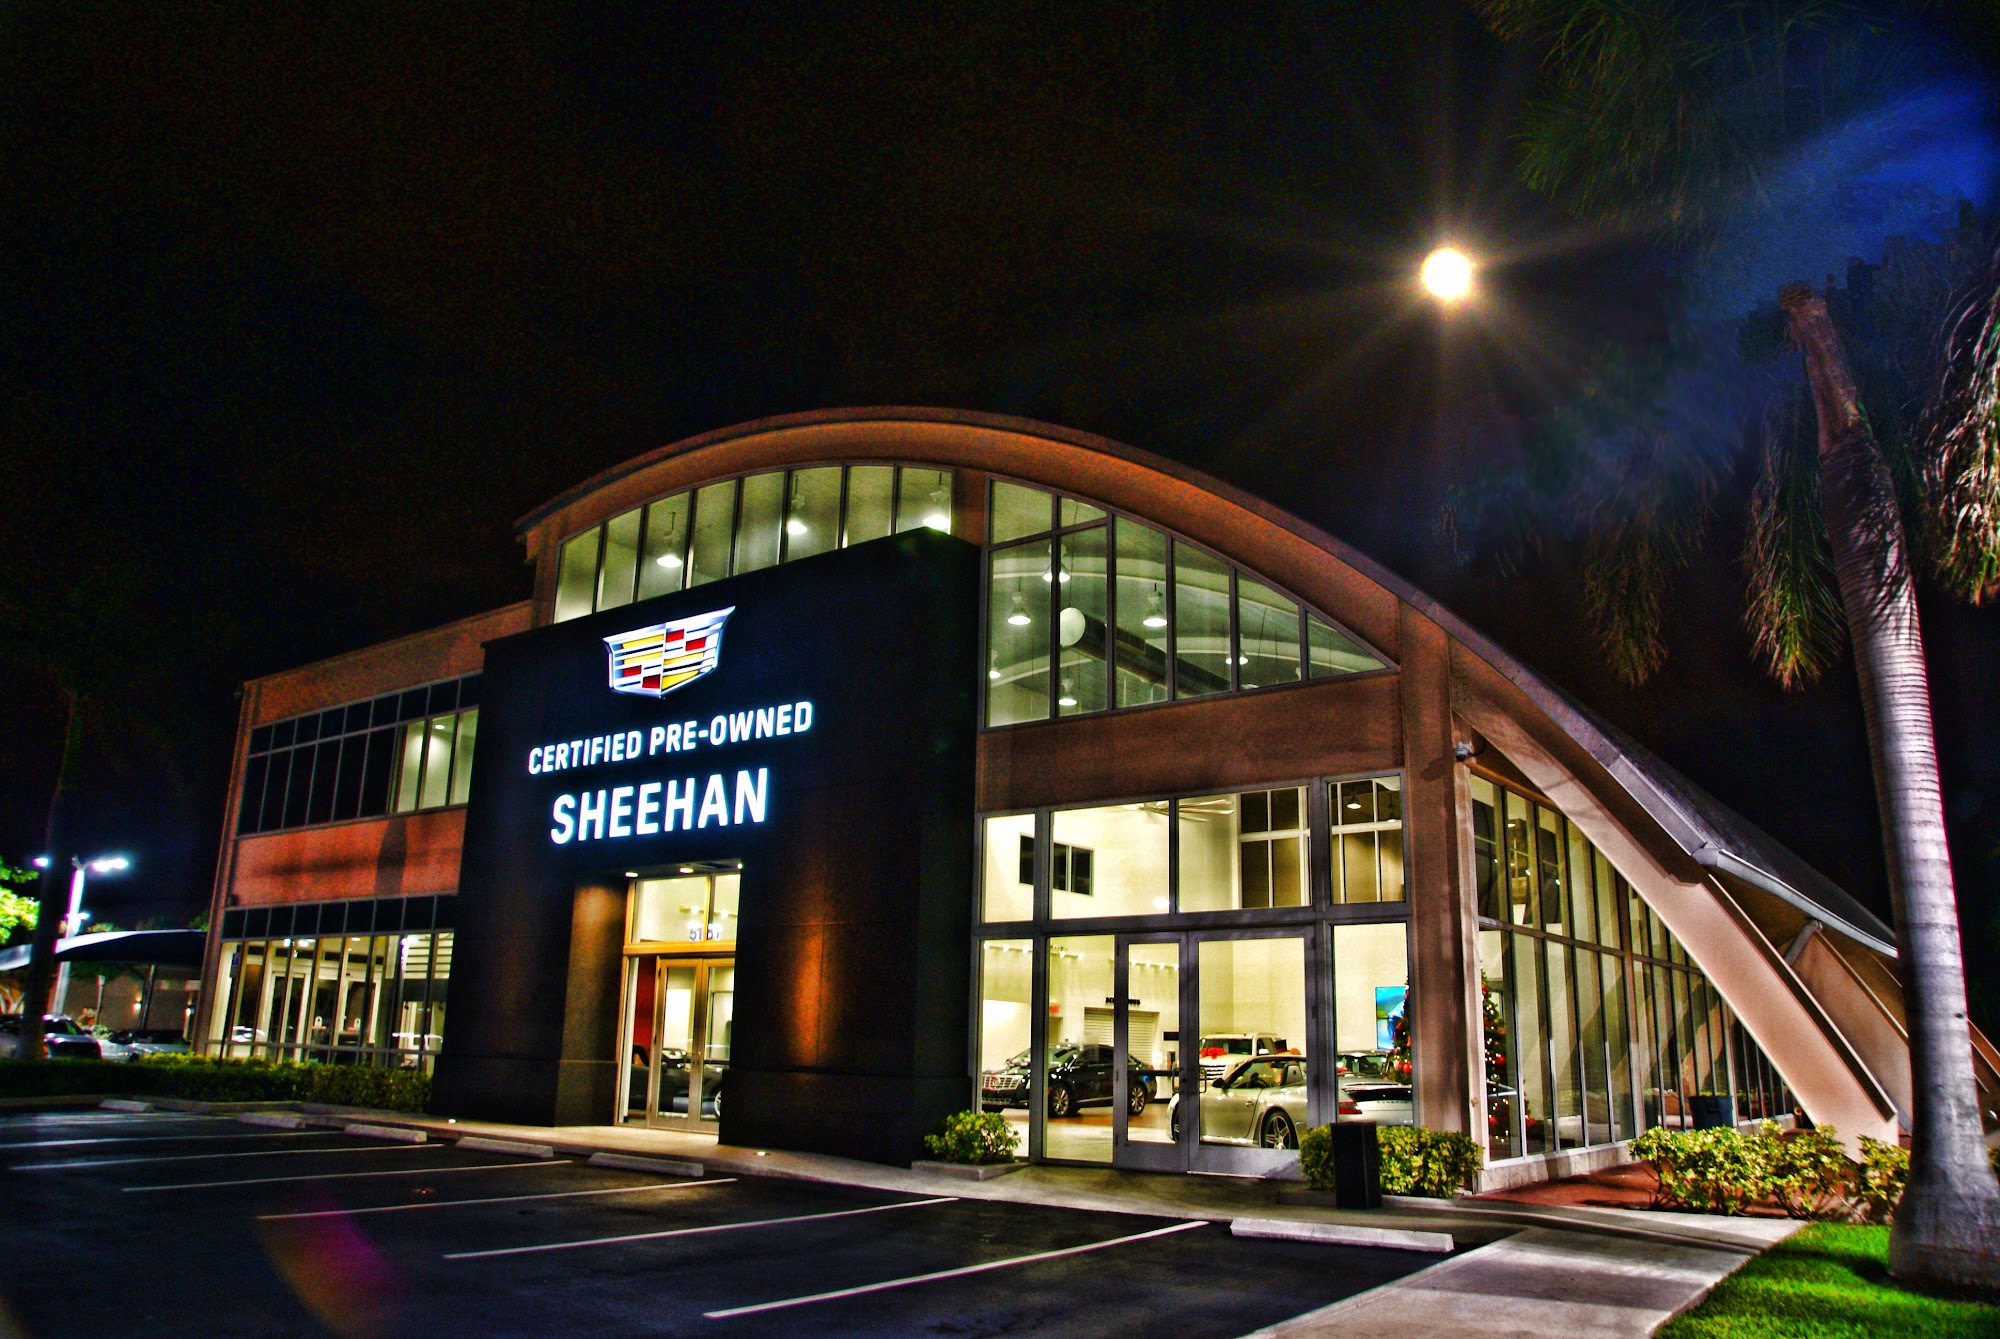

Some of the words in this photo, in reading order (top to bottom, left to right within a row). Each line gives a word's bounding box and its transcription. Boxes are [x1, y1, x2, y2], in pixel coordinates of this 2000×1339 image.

[528, 730, 642, 775] CERTIFIED
[649, 700, 813, 756] PRE-OWNED
[550, 767, 768, 845] SHEEHAN
